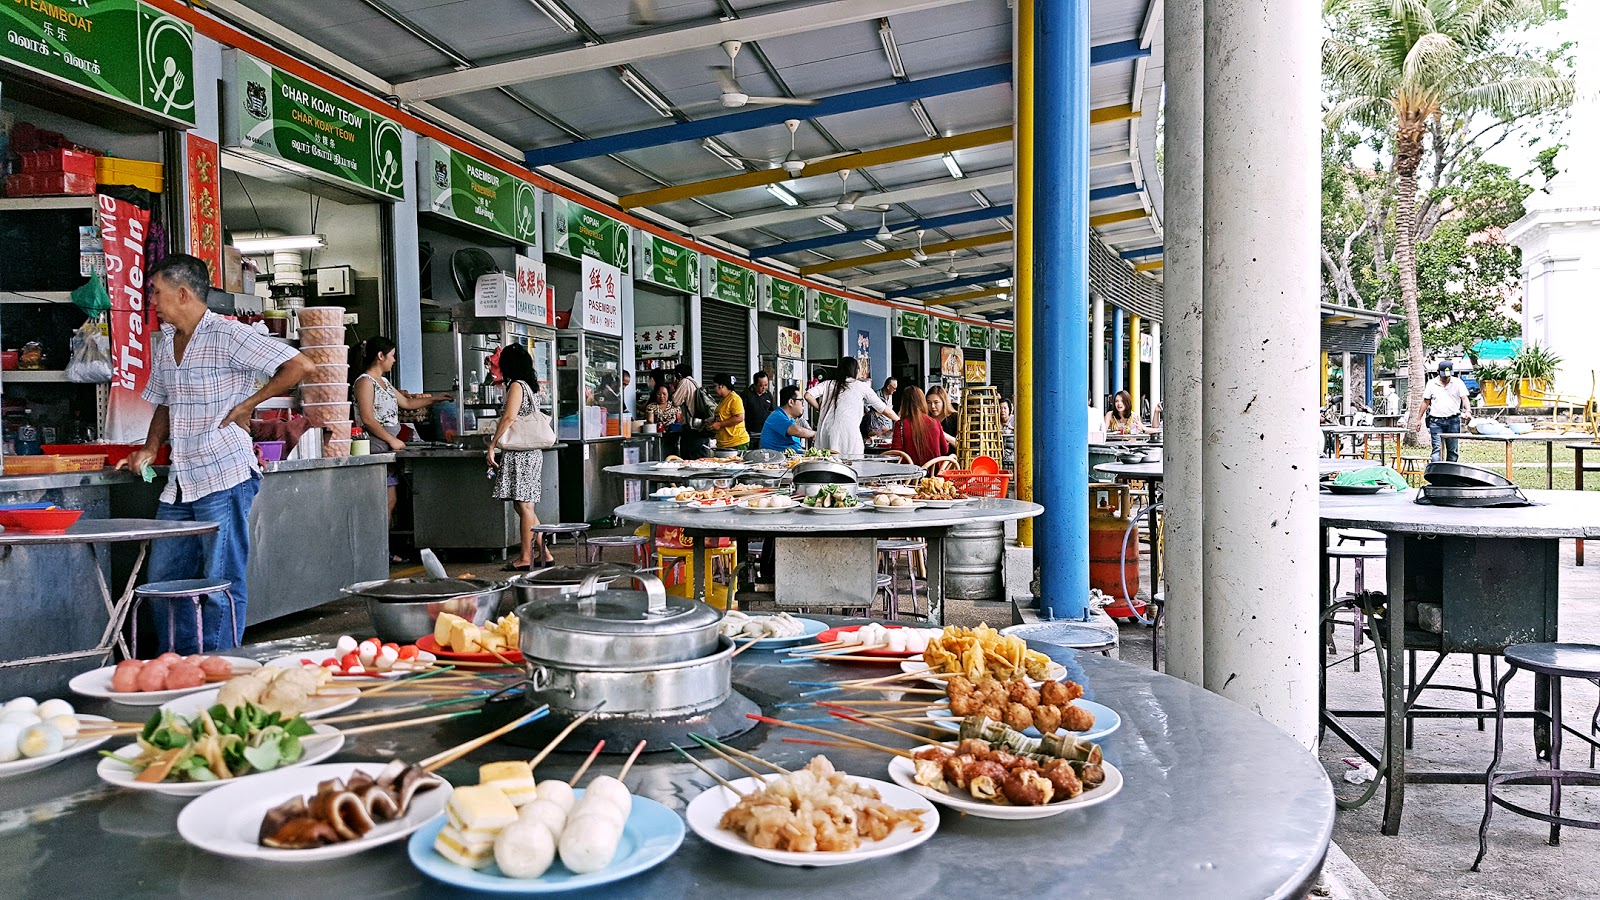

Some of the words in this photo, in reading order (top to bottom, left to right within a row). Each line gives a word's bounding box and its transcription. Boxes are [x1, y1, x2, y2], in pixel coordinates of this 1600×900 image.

[14, 0, 93, 32] TEAMBOAT
[282, 84, 309, 106] CHAR
[311, 96, 335, 117] KOAY
[337, 108, 362, 129] TEOW
[292, 109, 313, 126] CHAR
[314, 119, 334, 134] KOAY
[335, 127, 355, 142] TEOW
[467, 164, 500, 187] PASEMBUR
[583, 214, 600, 229] POPIAH
[588, 299, 617, 316] PASEMBUR
